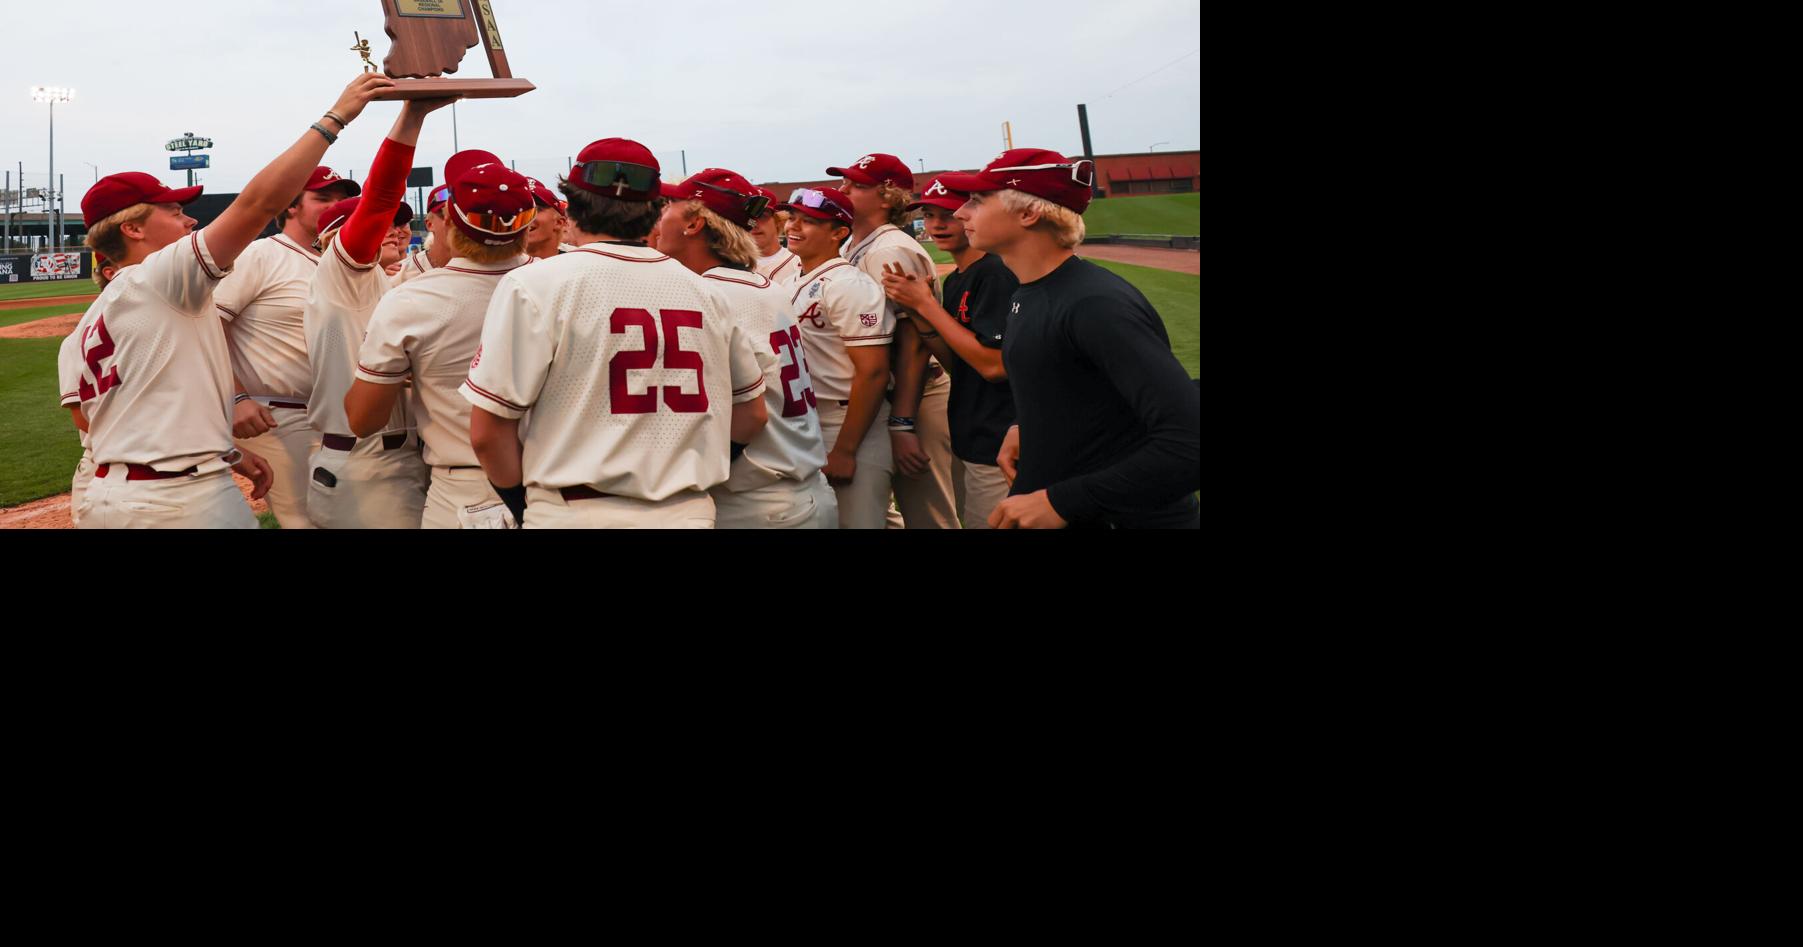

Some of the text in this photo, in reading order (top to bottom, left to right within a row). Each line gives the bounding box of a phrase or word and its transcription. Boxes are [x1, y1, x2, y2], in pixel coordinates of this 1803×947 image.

[481, 0, 501, 47] SAA
[925, 179, 948, 196] A
[609, 308, 709, 414] 25
